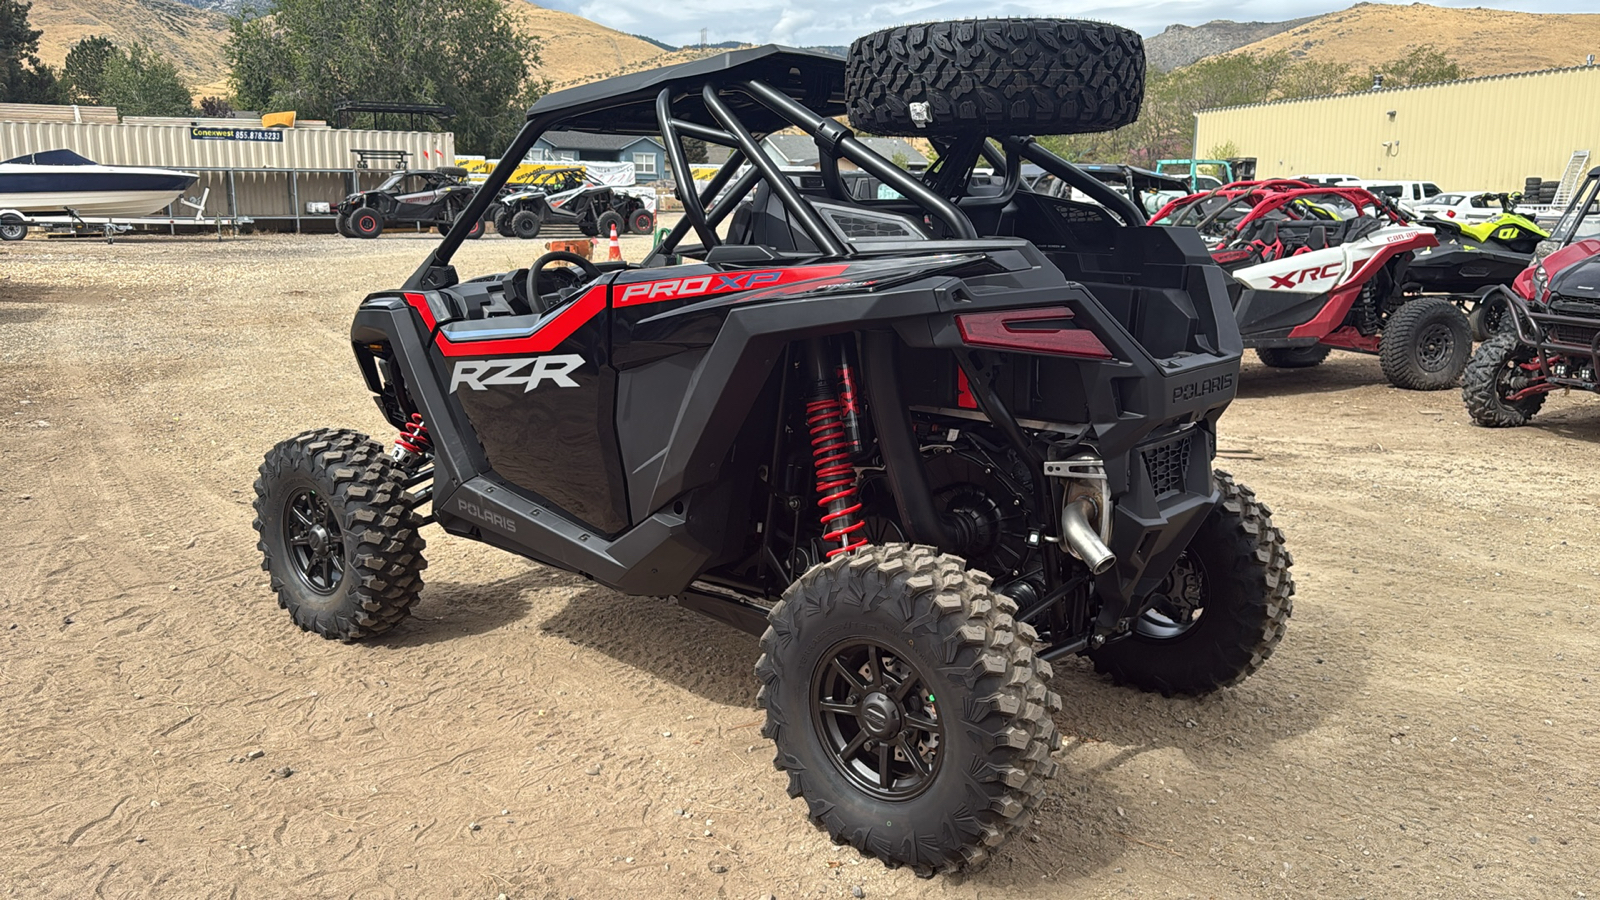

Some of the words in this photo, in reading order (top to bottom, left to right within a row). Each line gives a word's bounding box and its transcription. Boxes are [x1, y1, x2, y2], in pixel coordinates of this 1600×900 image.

[192, 128, 234, 137] Conexwest
[235, 131, 281, 140] 855.878.5233
[621, 276, 712, 302] PRO
[712, 271, 783, 291] XP
[1268, 262, 1342, 289] XRC
[449, 353, 586, 394] RZR
[1172, 373, 1233, 404] POLARIS
[457, 498, 517, 533] POLARIS
